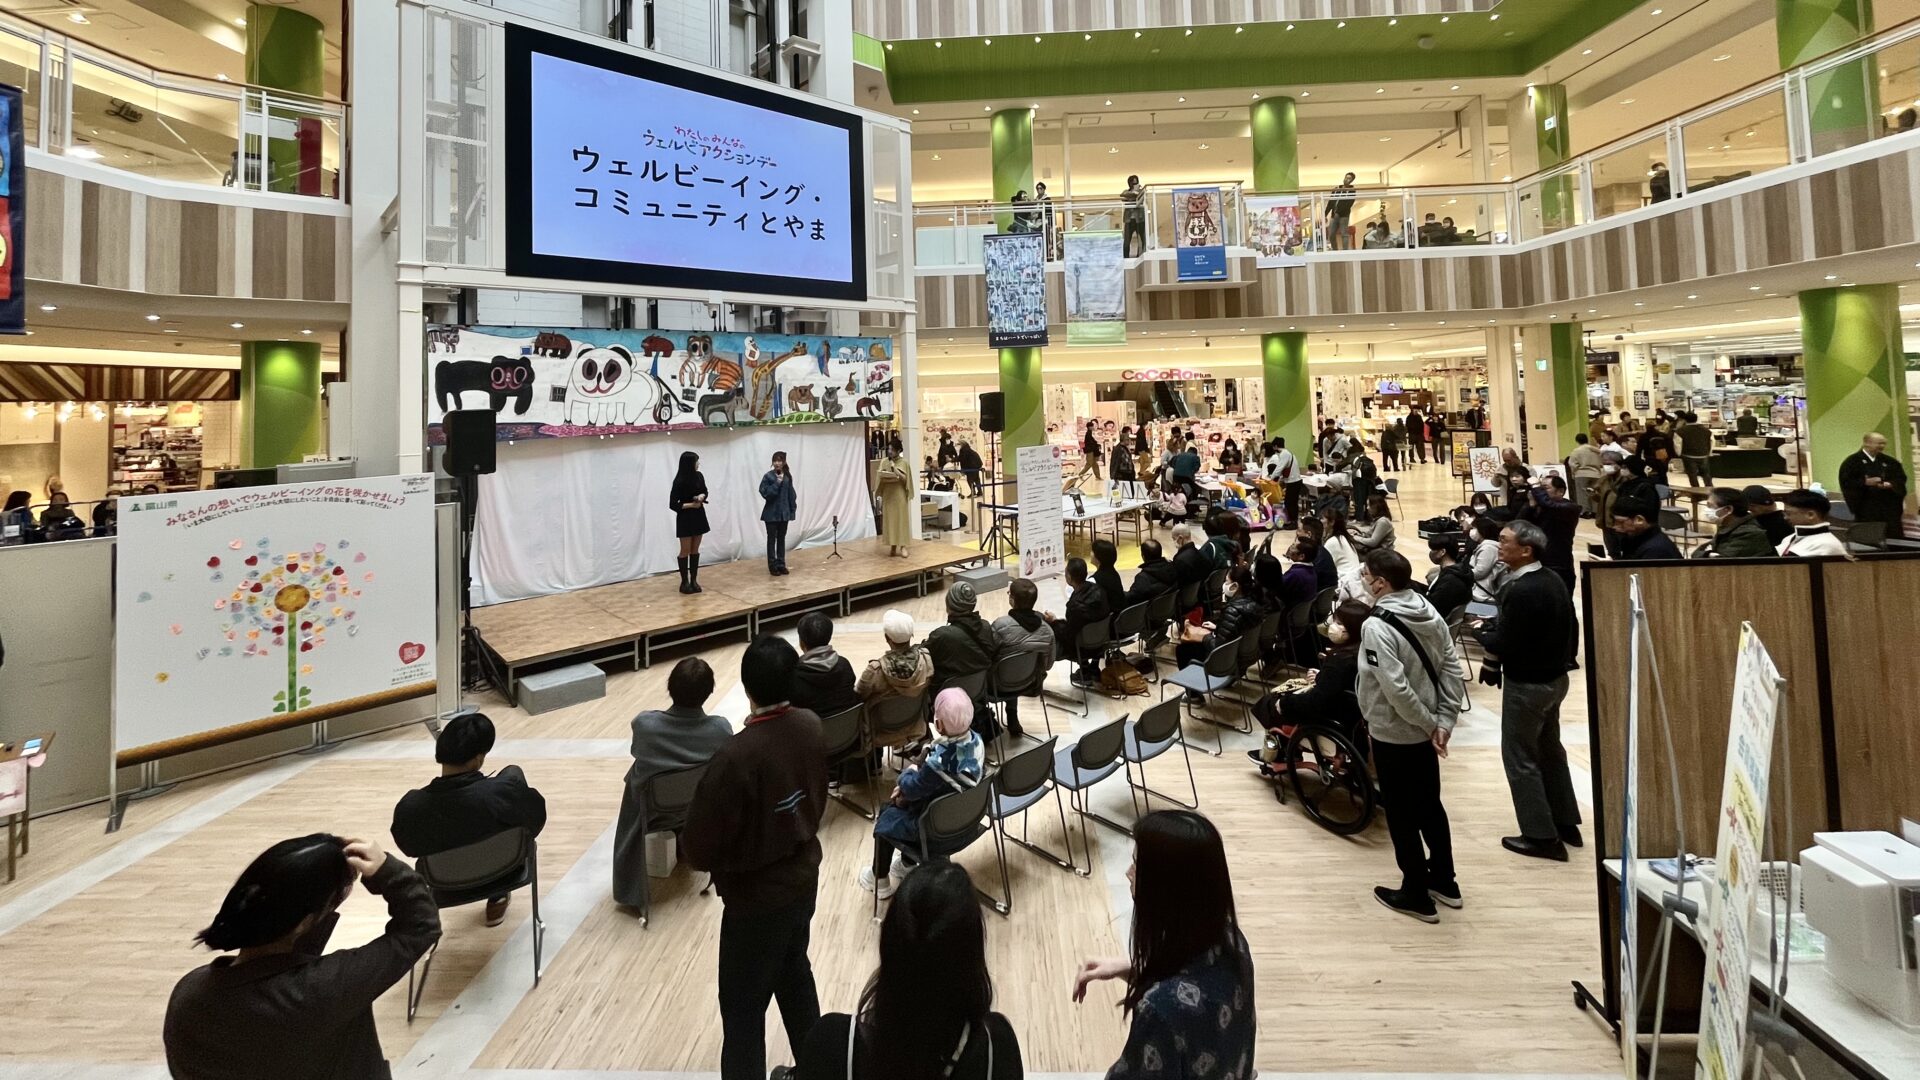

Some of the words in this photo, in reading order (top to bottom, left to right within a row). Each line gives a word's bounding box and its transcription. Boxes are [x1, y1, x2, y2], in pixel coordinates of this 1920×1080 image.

[643, 129, 777, 168] ウェルビアクションデー
[575, 188, 826, 241] コミュニティとやま
[1121, 368, 1193, 380] CoCoRo
[166, 486, 406, 526] みなさんの想いでウェルビーイングの花を咲かせましょう
